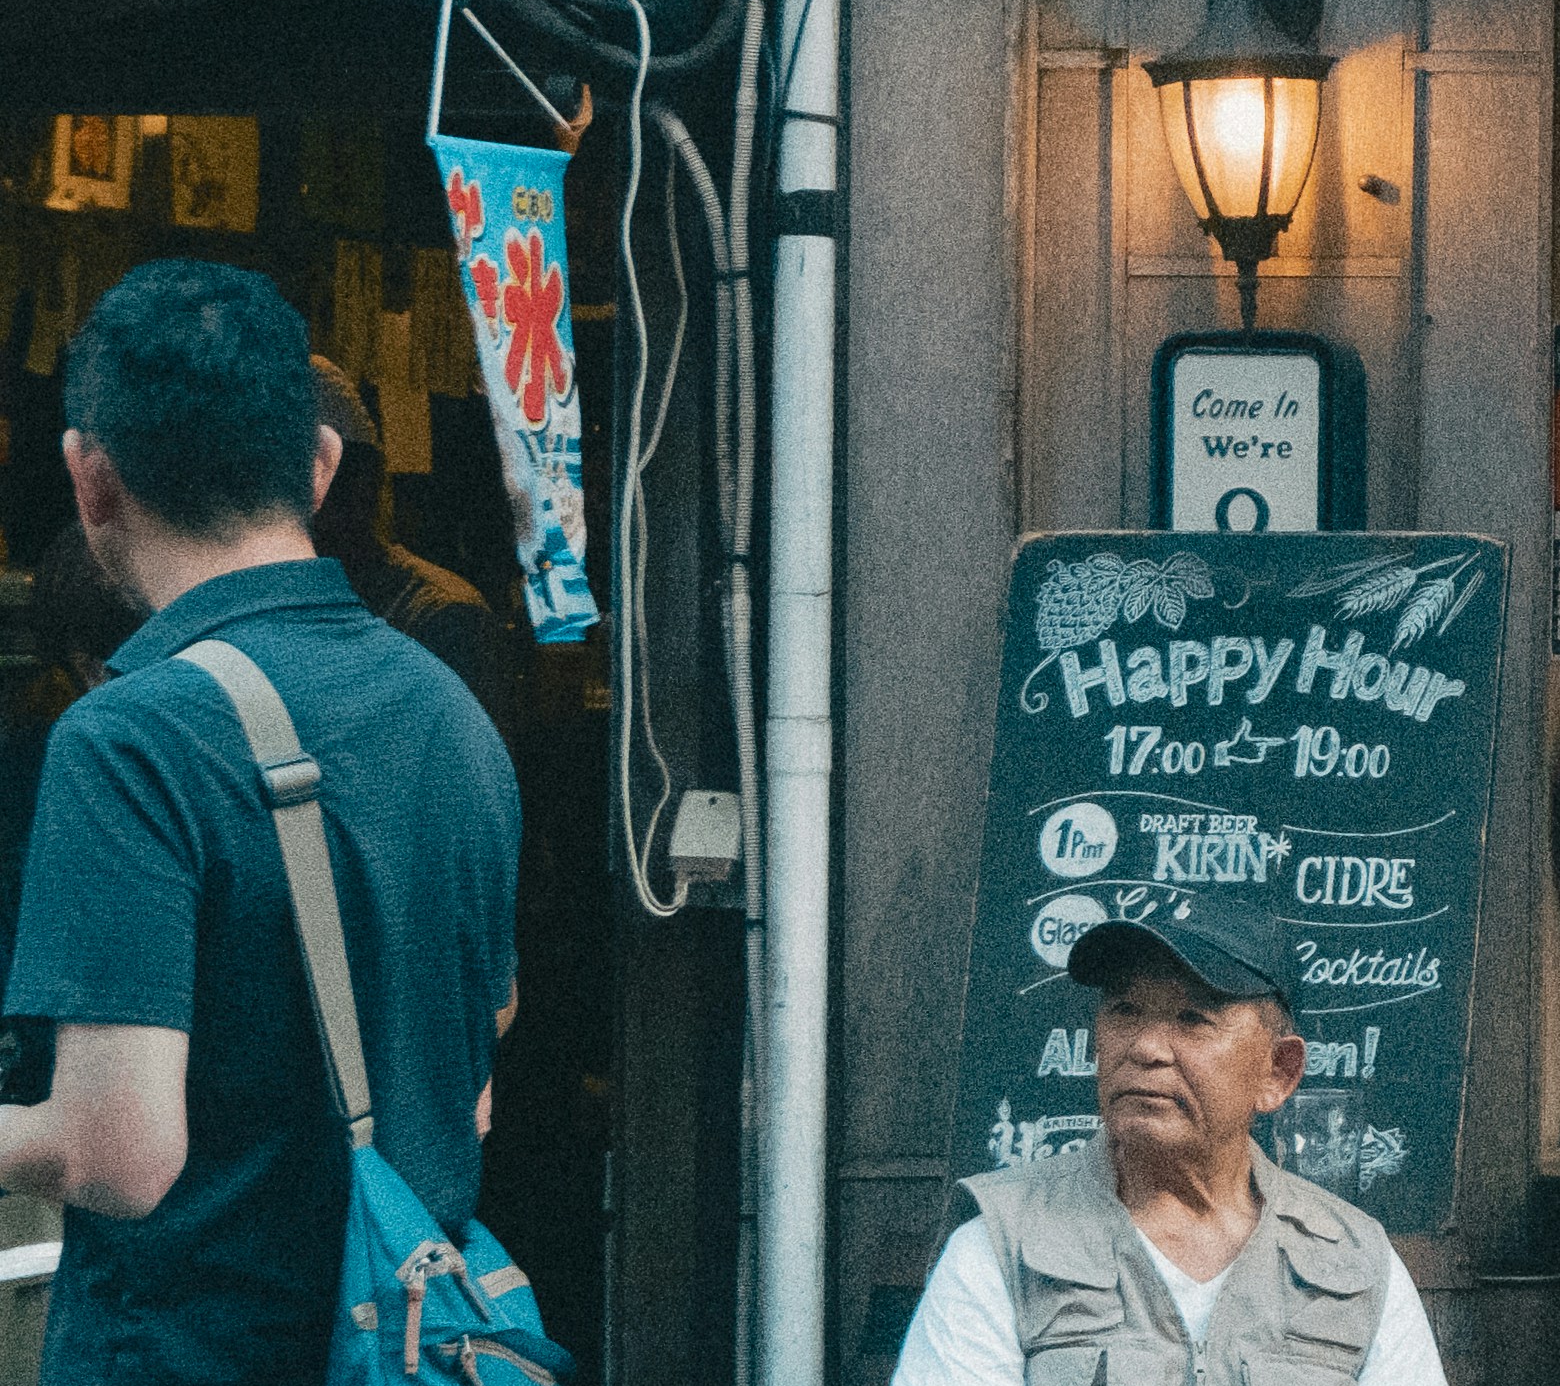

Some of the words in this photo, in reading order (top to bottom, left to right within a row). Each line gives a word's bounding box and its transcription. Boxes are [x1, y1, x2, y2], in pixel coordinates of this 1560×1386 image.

[1191, 388, 1265, 420] Come
[1274, 390, 1300, 419] In
[1201, 434, 1294, 459] We're
[1059, 636, 1296, 717] Happy
[1296, 623, 1466, 722] Hour
[1104, 724, 1206, 775] 17:00
[1289, 724, 1391, 778] 19:00
[1139, 813, 1203, 833] DRAFT
[1207, 814, 1259, 835] BEER
[1152, 832, 1274, 883] KIRIN
[1296, 855, 1416, 909] CIDRE
